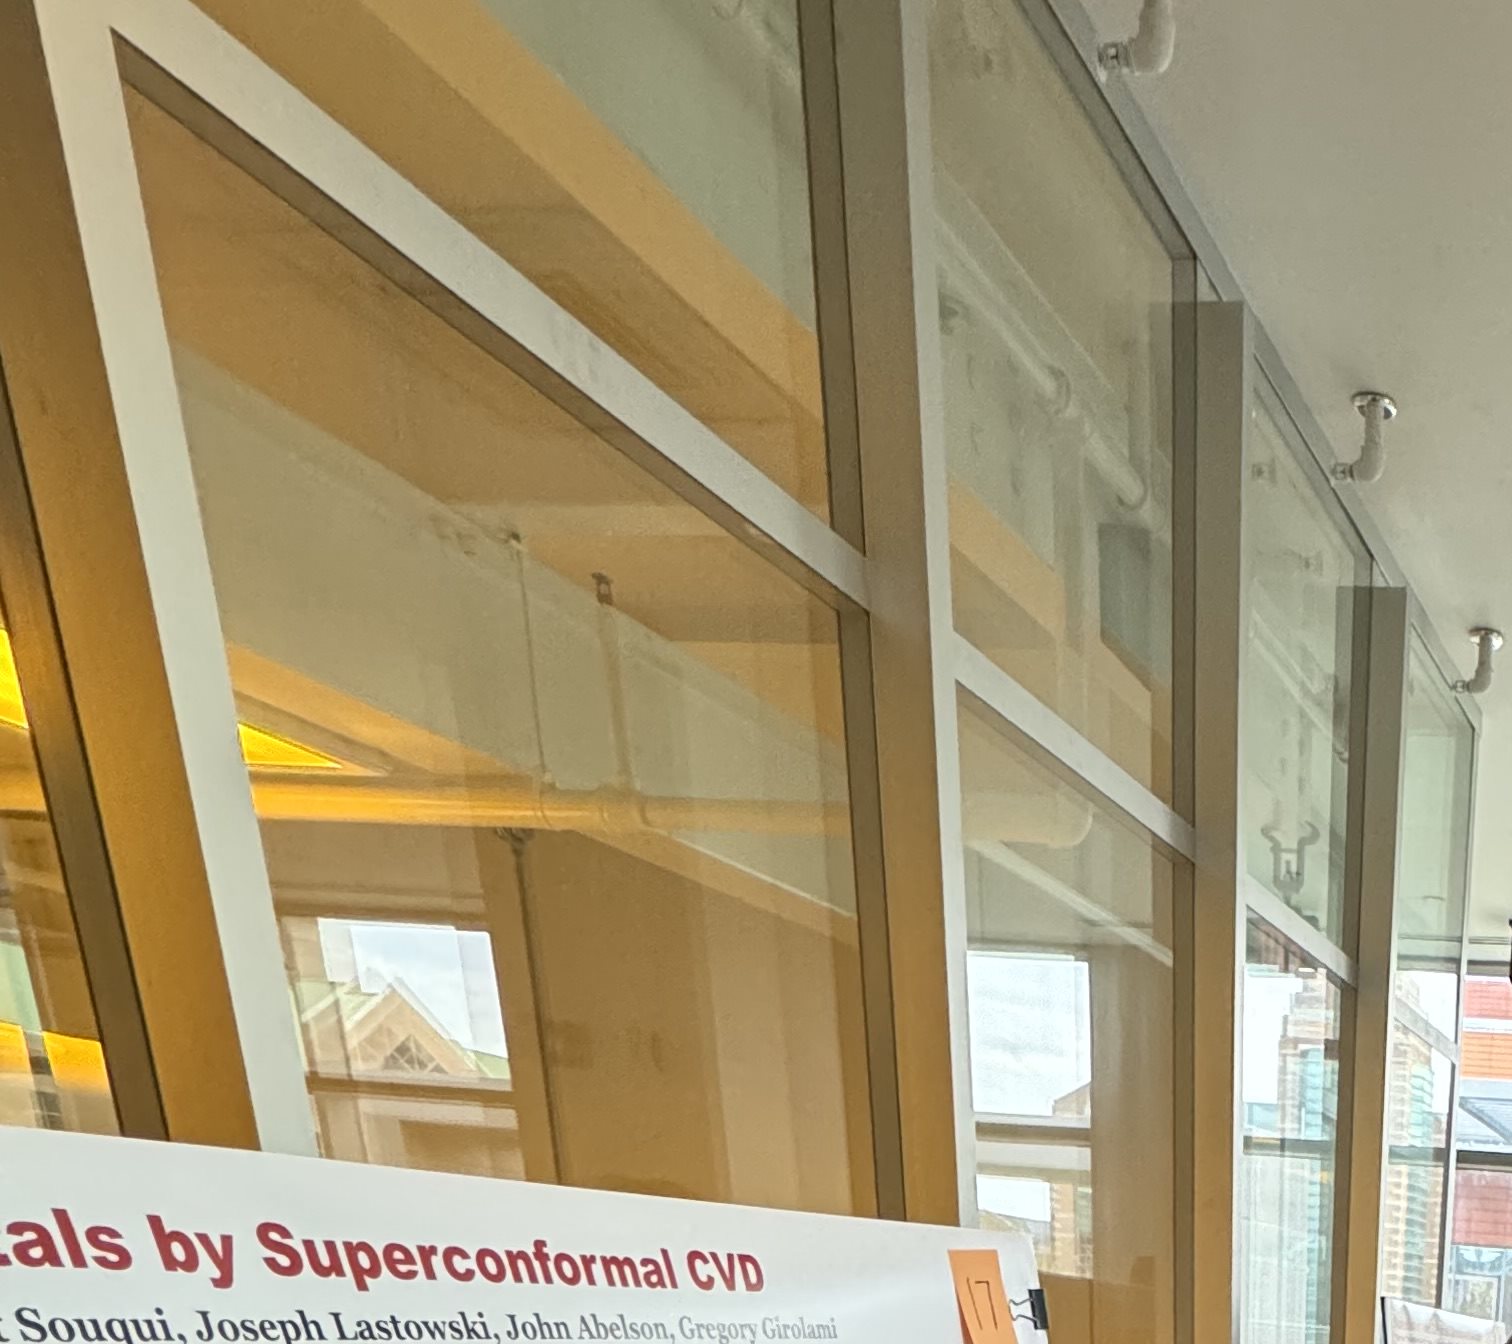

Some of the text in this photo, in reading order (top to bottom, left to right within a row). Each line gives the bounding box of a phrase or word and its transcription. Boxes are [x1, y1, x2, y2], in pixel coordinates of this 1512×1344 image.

[0, 1208, 765, 1293] als by Superconformal CVD
[505, 1313, 573, 1341] John
[761, 1317, 838, 1341] Girolami
